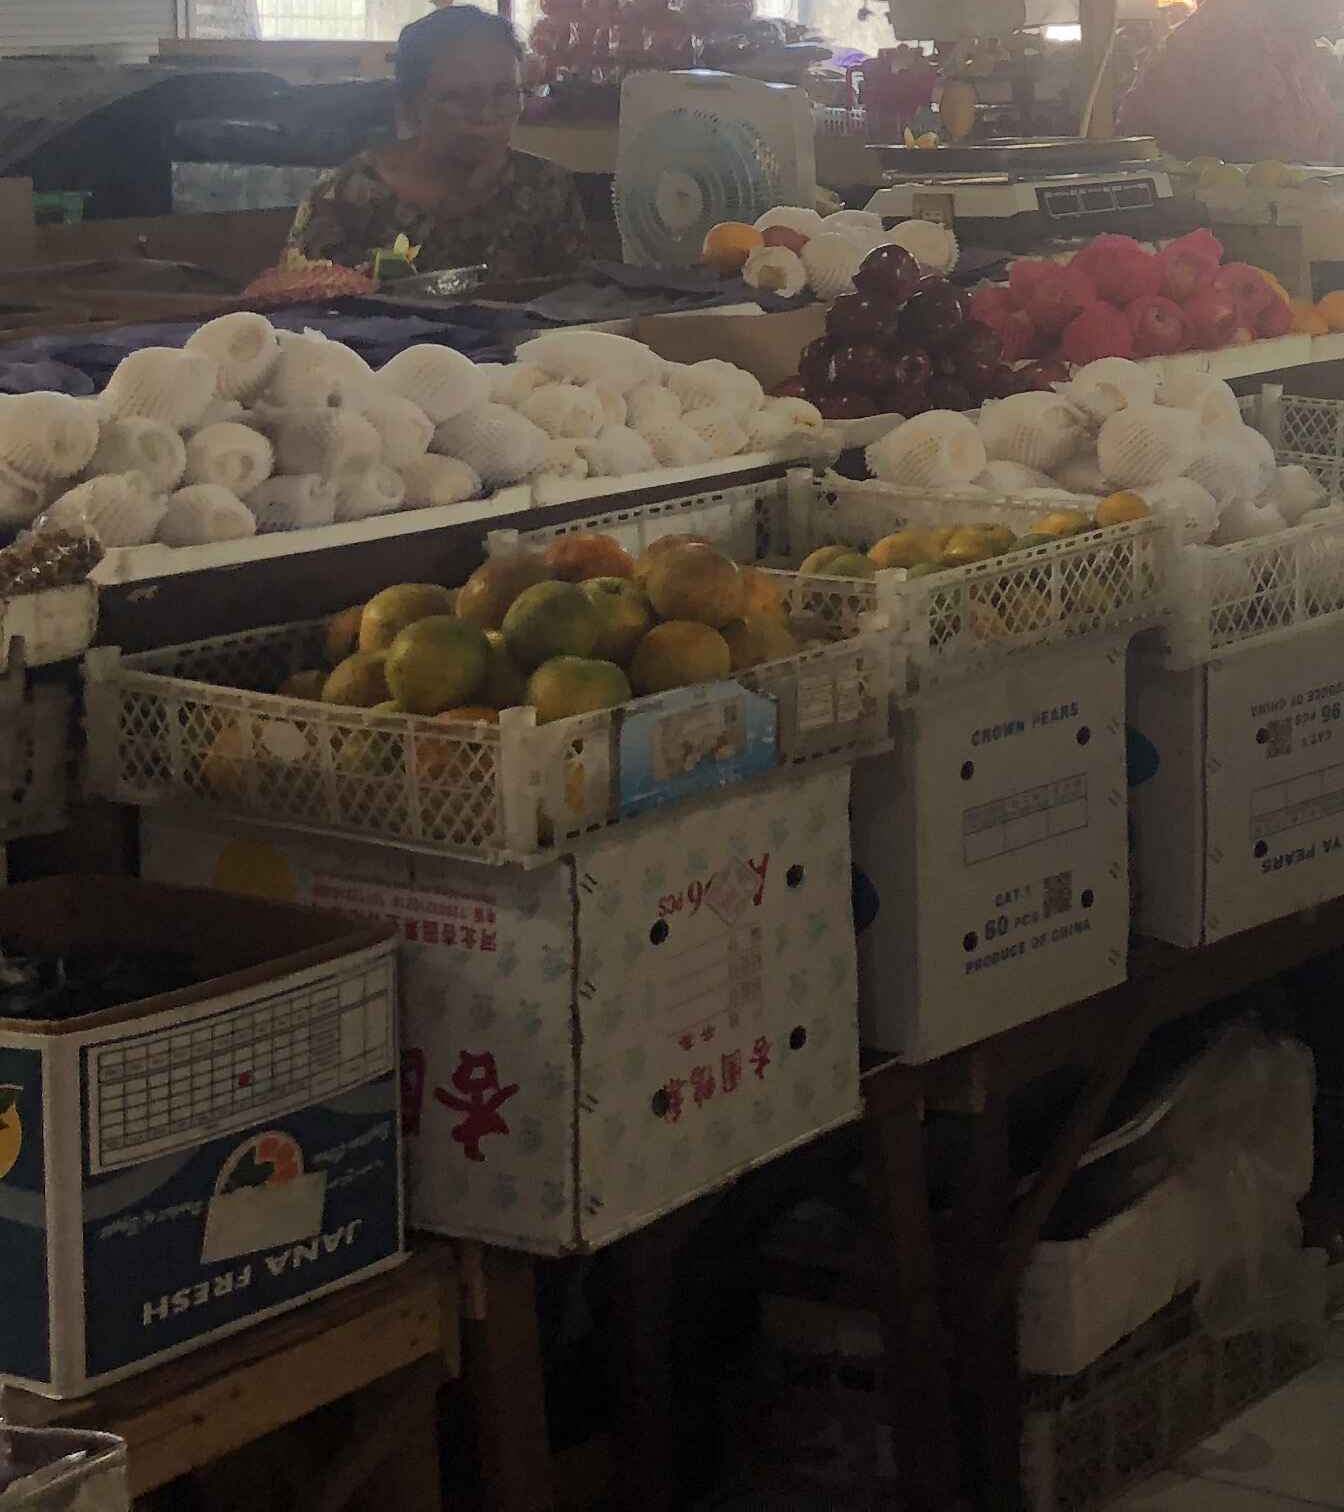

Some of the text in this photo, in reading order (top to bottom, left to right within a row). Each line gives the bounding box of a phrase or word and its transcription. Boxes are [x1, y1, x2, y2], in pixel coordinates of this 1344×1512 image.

[970, 720, 1026, 747] CROWN
[264, 1217, 363, 1276] JANA
[140, 1264, 252, 1329] FRESH
